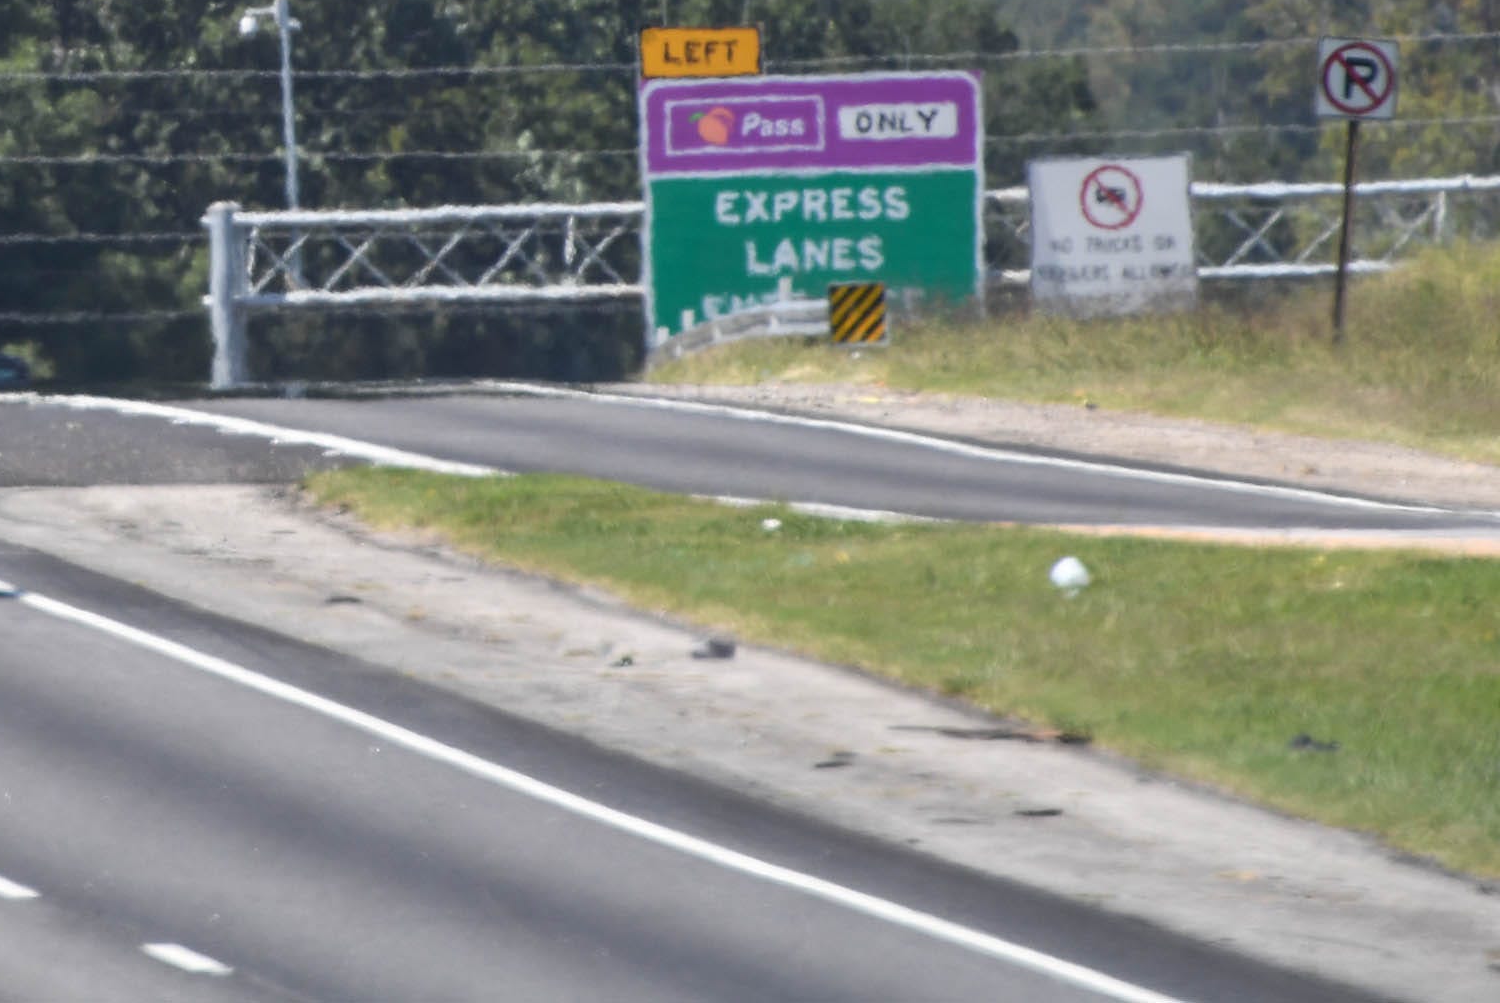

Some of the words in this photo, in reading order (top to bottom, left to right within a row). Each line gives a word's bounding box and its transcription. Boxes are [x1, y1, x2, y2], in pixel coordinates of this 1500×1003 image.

[663, 39, 739, 66] LEFT
[741, 112, 805, 138] Pass
[855, 109, 938, 133] ONLY
[715, 186, 911, 224] EXPRESS
[745, 235, 885, 276] LANES
